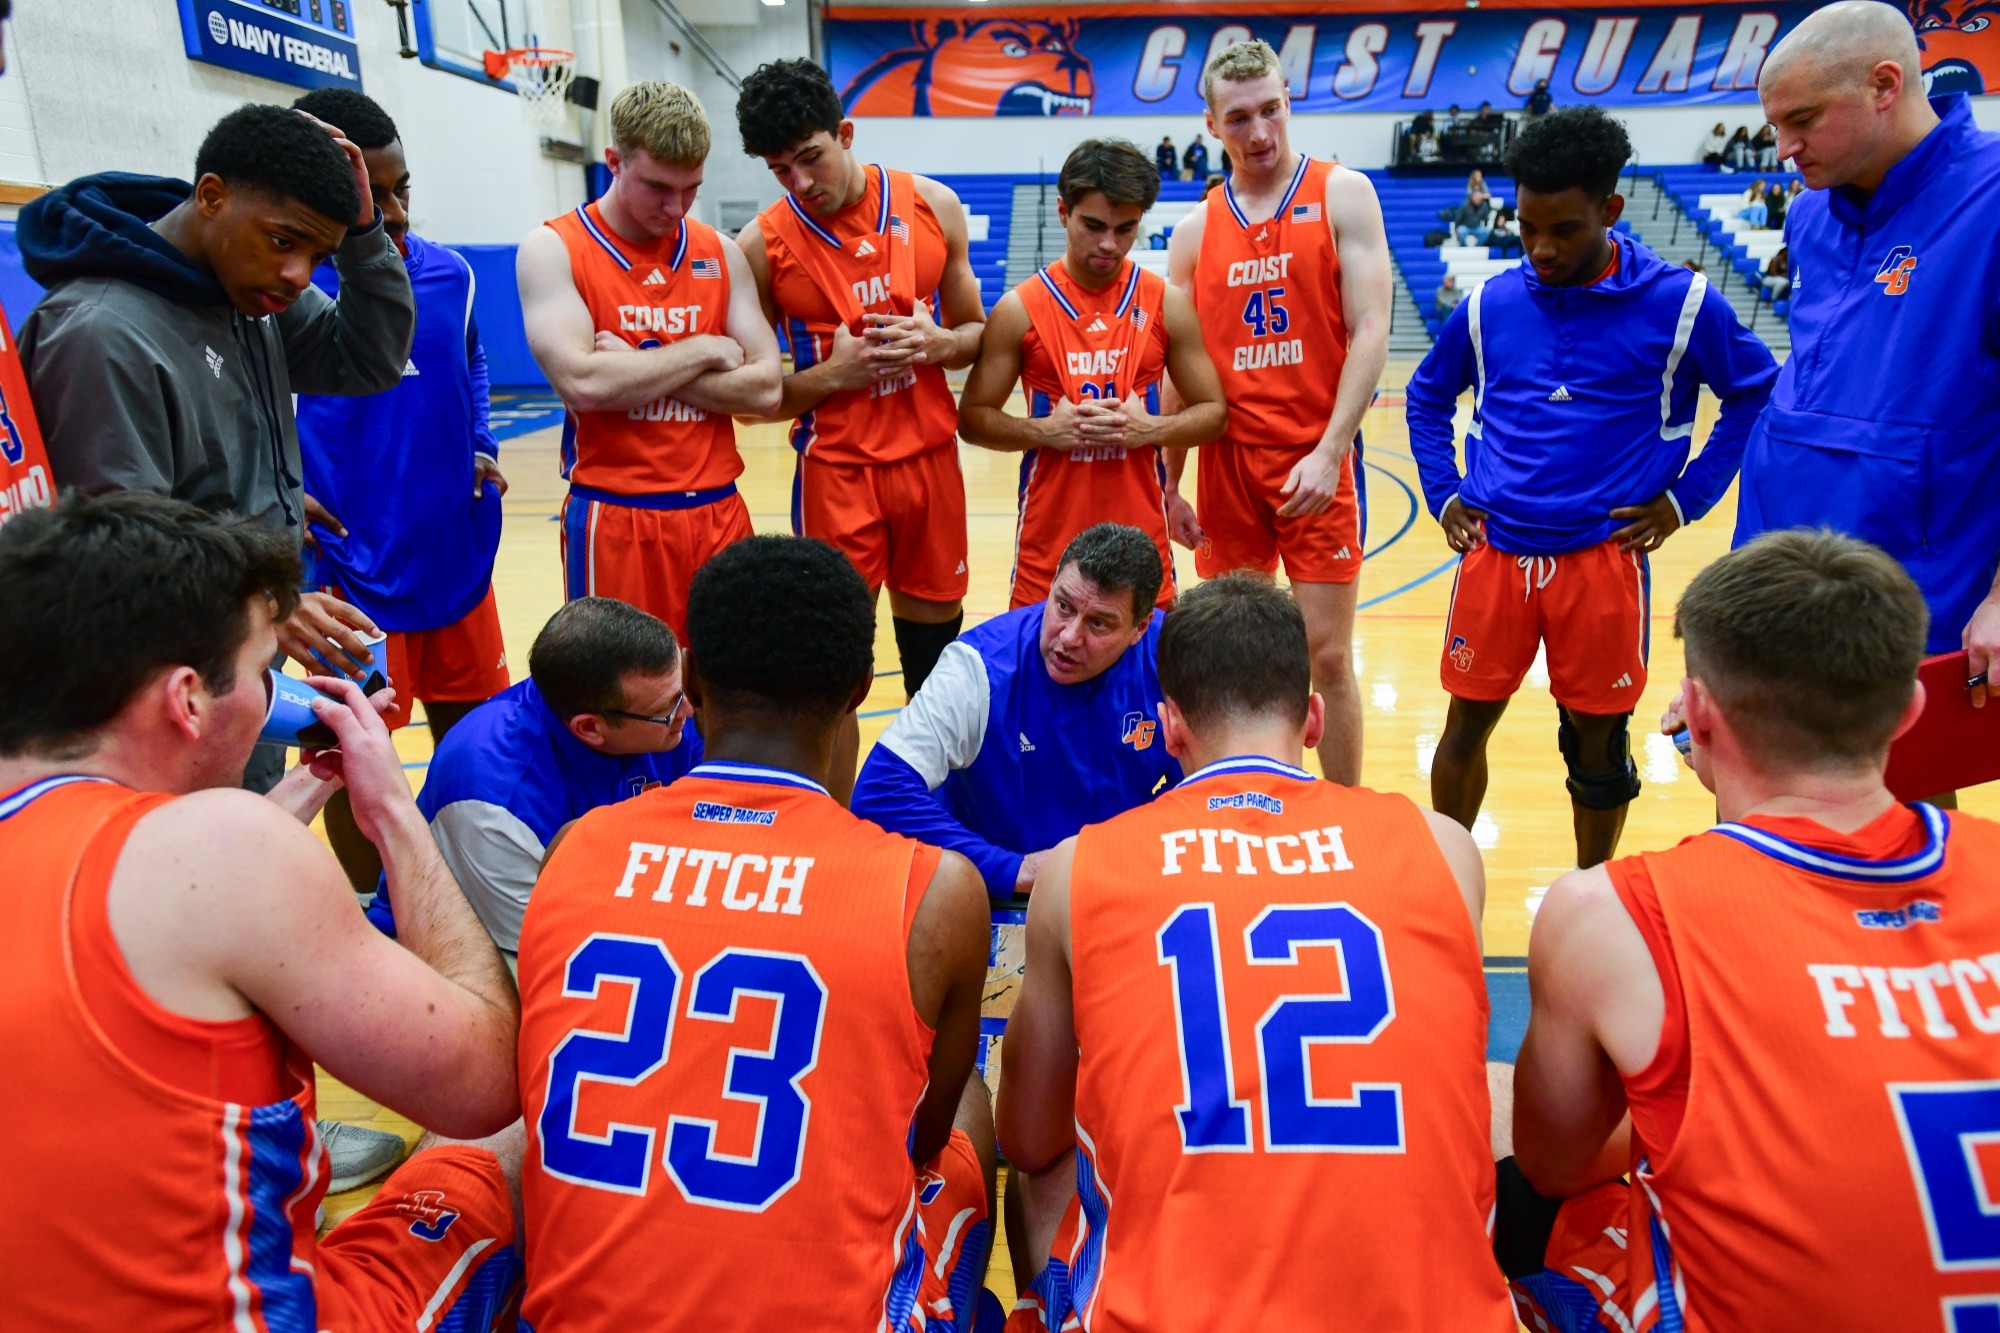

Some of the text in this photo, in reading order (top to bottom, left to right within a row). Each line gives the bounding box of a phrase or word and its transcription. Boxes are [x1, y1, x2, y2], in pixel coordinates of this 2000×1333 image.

[228, 18, 355, 80] NAVY FEDERAL
[1507, 12, 1780, 95] GUAR
[1227, 252, 1293, 287] COAST
[618, 305, 702, 334] COAST
[1242, 287, 1290, 337] 45
[1067, 347, 1128, 376] COAST
[1233, 339, 1303, 371] GUARD
[692, 801, 778, 825] SEMPER PARATUS
[1208, 792, 1283, 814] SEMPER PARATUS
[1161, 826, 1354, 875] FITCH
[614, 842, 814, 915] FITCH
[1806, 952, 2000, 1039] FITC
[1155, 902, 1406, 1154] 12
[536, 932, 829, 1213] 23
